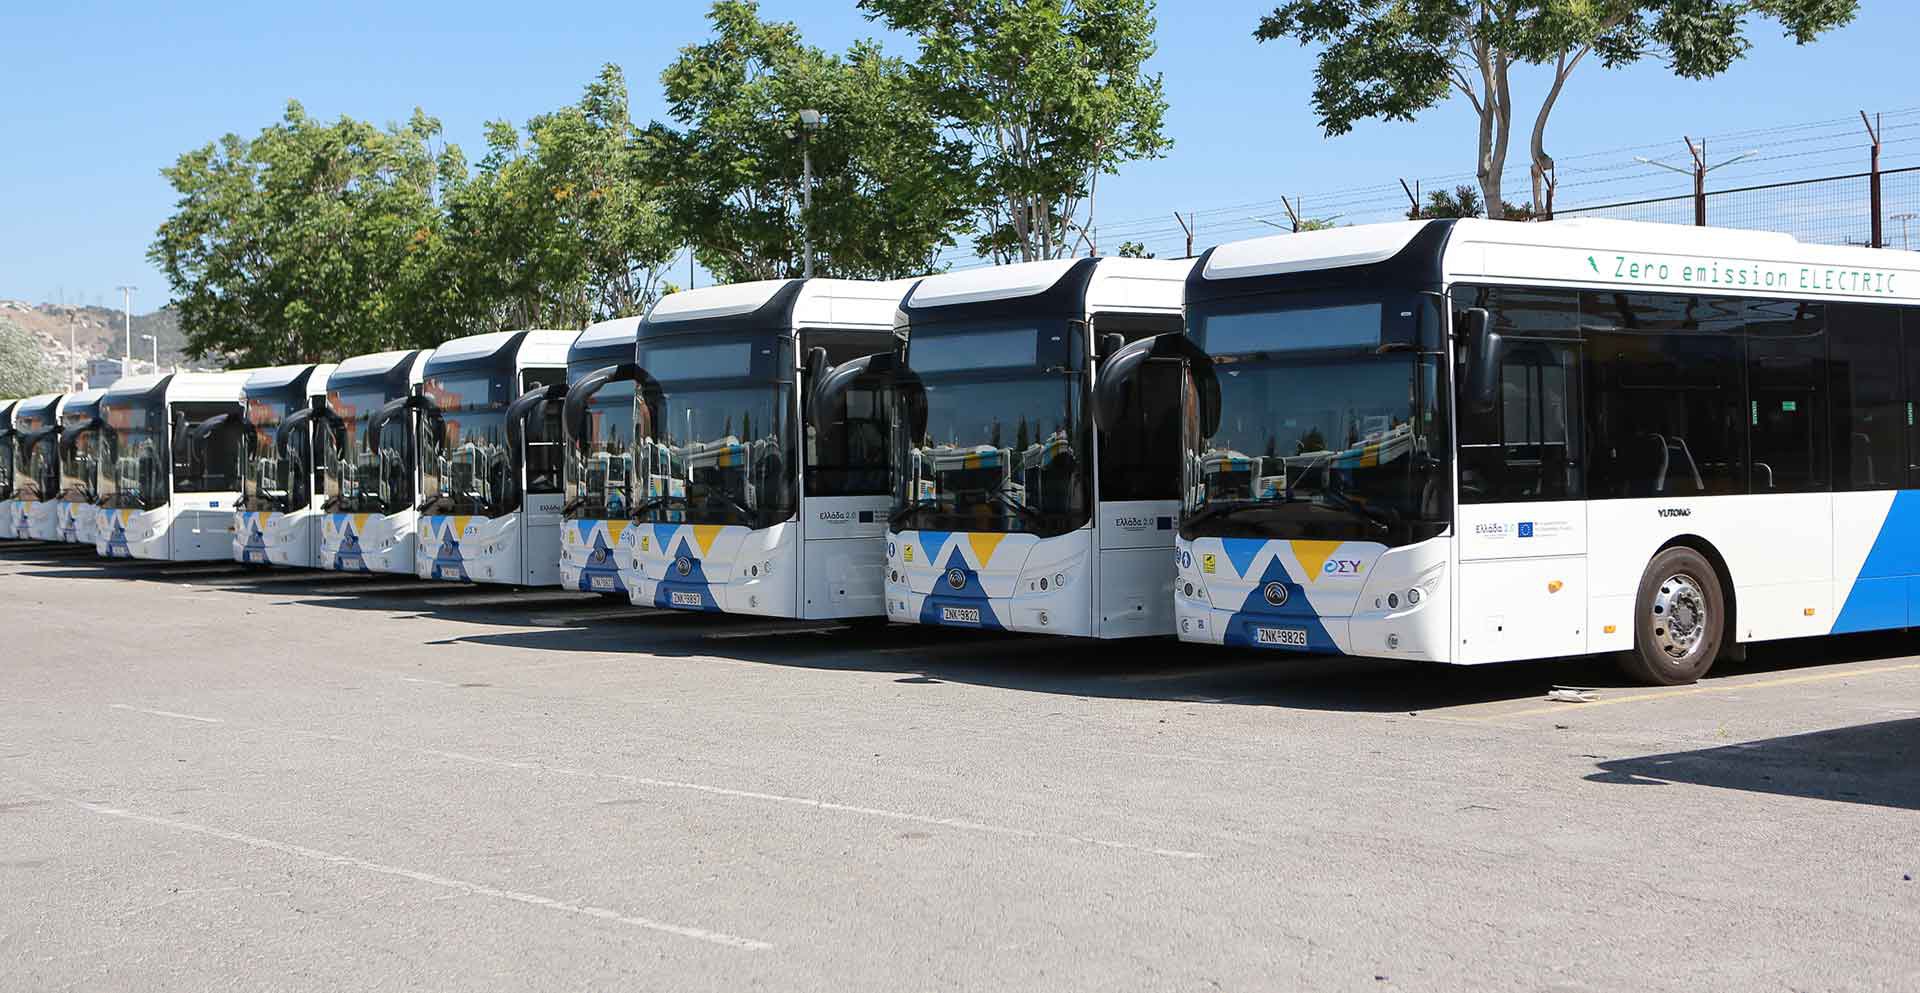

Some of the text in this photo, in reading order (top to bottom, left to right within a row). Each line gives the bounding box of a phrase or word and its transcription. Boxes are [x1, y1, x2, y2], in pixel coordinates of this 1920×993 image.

[1615, 256, 1897, 293] Zero emission ELECTRIC
[1657, 508, 1692, 518] YUTONG
